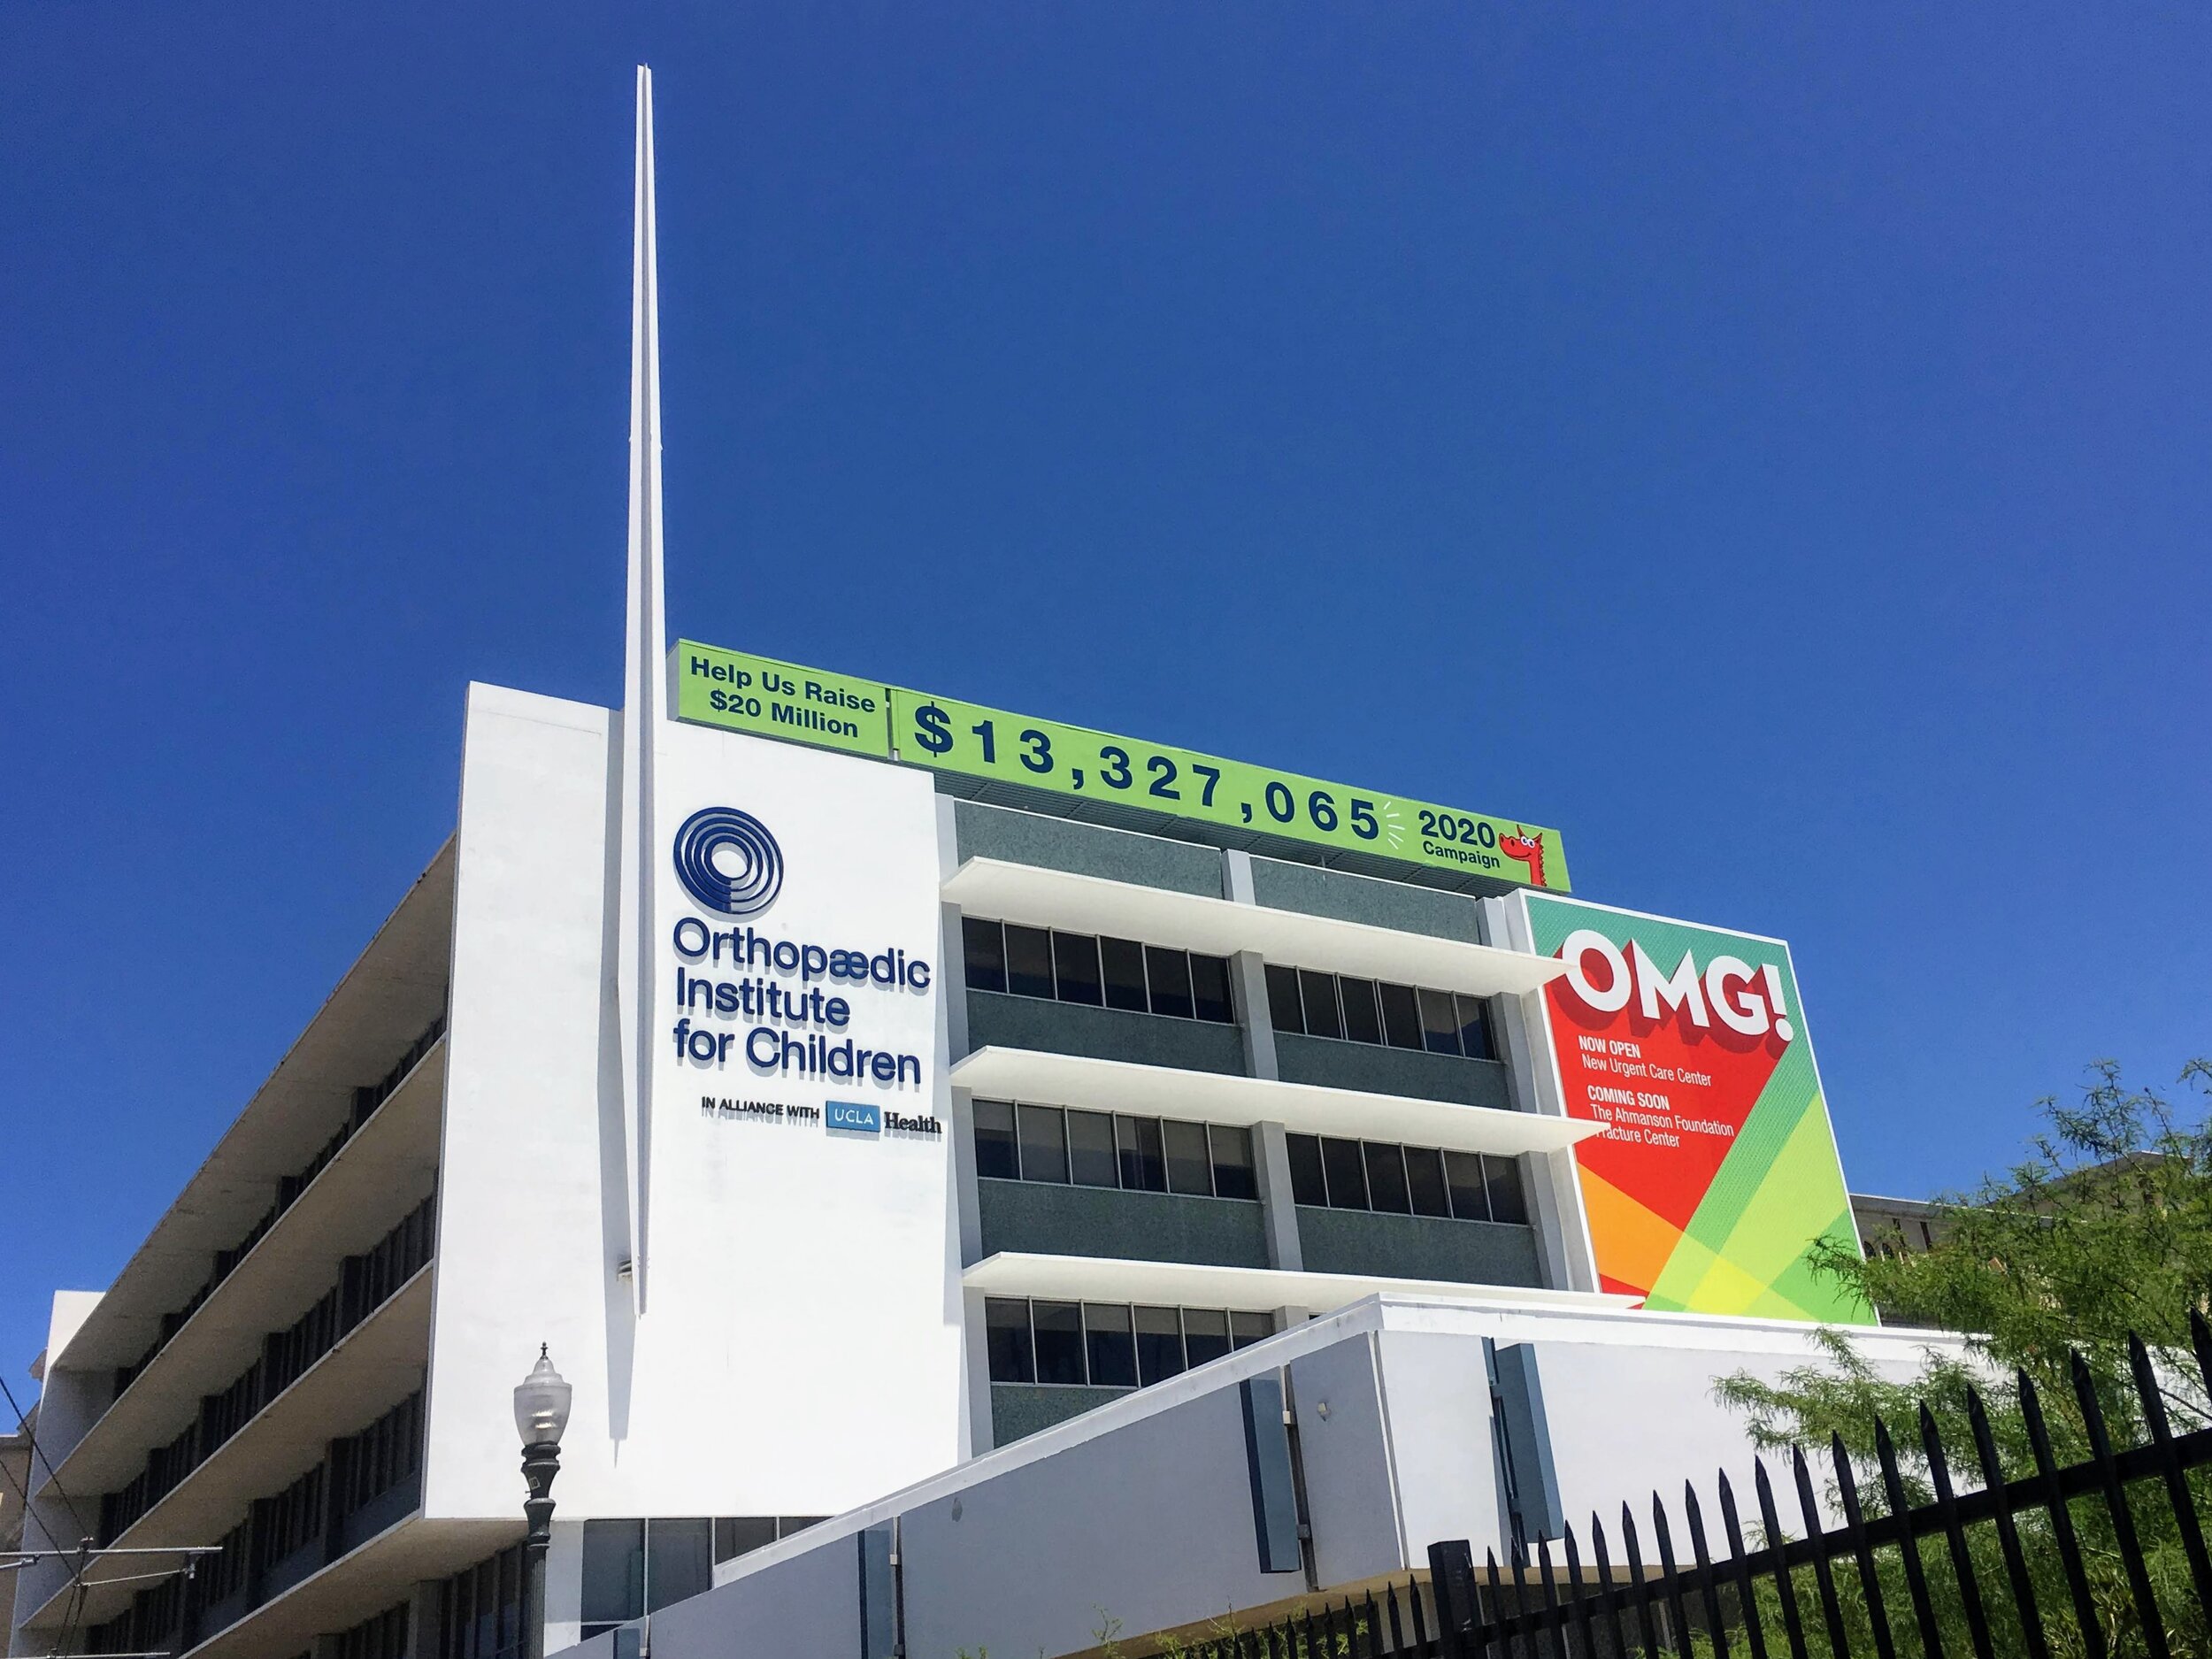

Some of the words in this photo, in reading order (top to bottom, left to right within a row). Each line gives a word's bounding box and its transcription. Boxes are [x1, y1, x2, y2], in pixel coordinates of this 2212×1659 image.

[691, 656, 752, 688] Help
[762, 672, 795, 695] Us
[805, 681, 876, 712] Raise
[710, 688, 761, 717] $20
[772, 703, 858, 738] Million
[914, 701, 1379, 840] $13,327,065
[1418, 810, 1495, 849] 2020
[1423, 841, 1501, 869] Campaign
[673, 917, 931, 988] Orthopædic
[677, 967, 850, 1025] Institute
[1562, 929, 1793, 1041] OMG!
[673, 1018, 735, 1063] for
[746, 1027, 921, 1085] Children
[1578, 1035, 1606, 1053] NOW
[1609, 1041, 1640, 1058] OPEN
[1582, 1054, 1607, 1071] New
[1609, 1058, 1647, 1078] Urgent
[1649, 1064, 1674, 1081] Care
[1677, 1068, 1711, 1087] Center
[702, 1096, 715, 1109] IN
[719, 1098, 783, 1116] ALLIANCE
[787, 1105, 819, 1118] WITH
[834, 1109, 874, 1125] UCLA
[884, 1111, 942, 1133] Health
[1587, 1085, 1635, 1106] COMING
[1638, 1092, 1670, 1110] SOON
[1590, 1104, 1612, 1121] The
[1616, 1107, 1672, 1129] Ahmanson
[1675, 1115, 1734, 1137] Foundation
[1596, 1125, 1641, 1142] racture
[1644, 1129, 1679, 1147] Center
